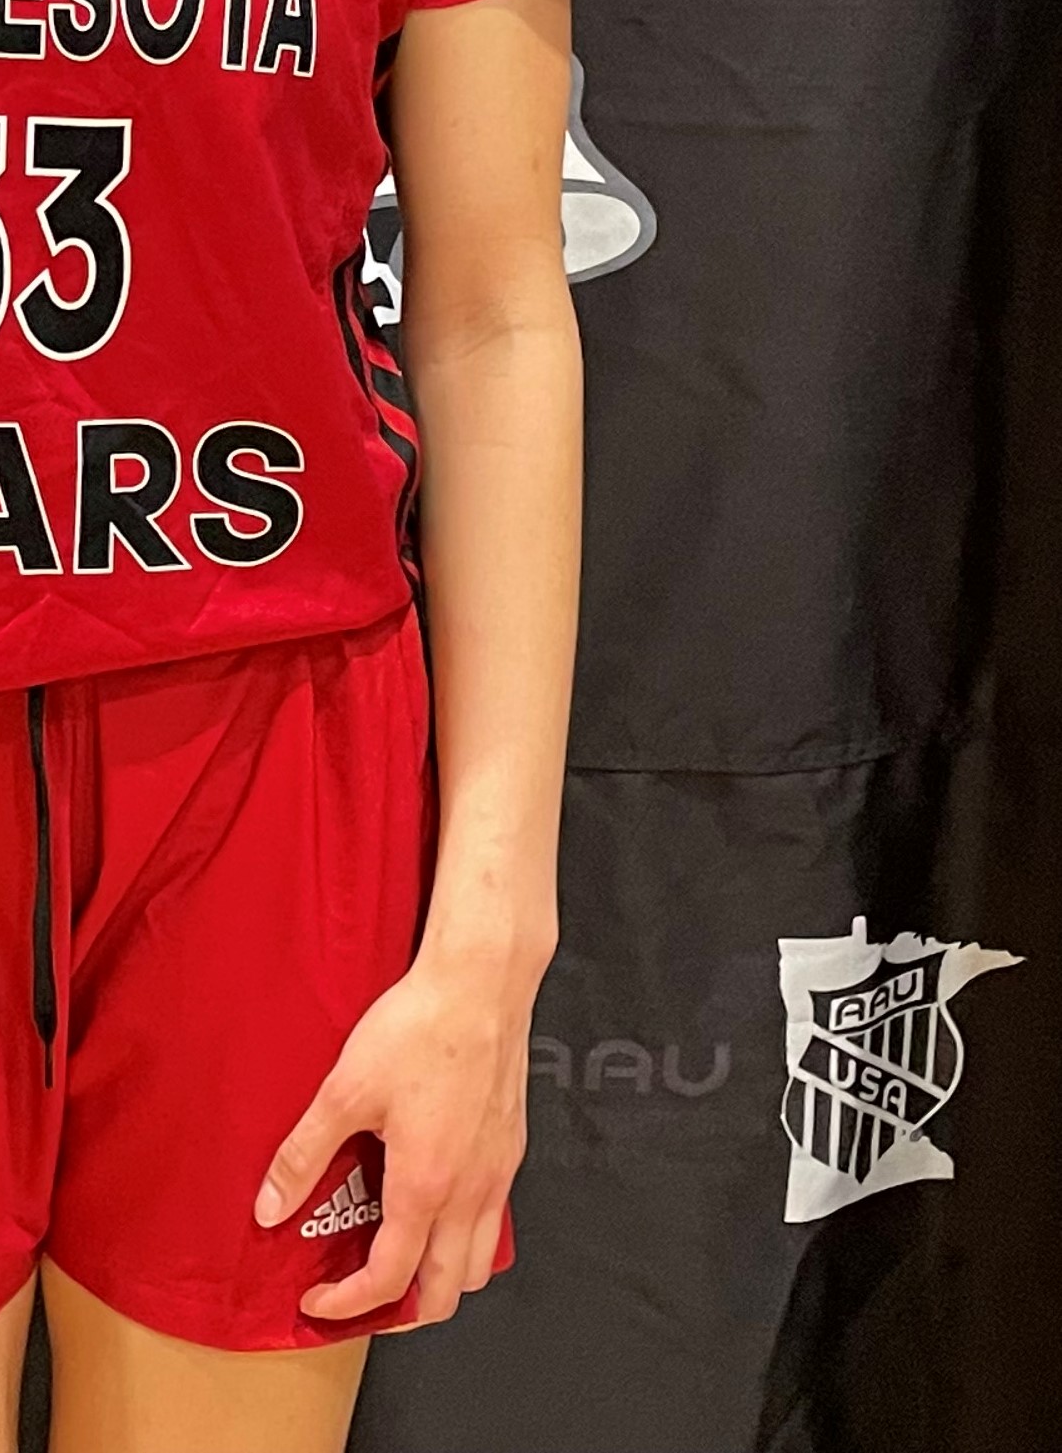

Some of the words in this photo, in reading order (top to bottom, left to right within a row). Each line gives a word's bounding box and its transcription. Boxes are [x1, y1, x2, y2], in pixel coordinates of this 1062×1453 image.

[835, 971, 917, 1028] AAU
[828, 1048, 907, 1118] USA
[300, 1201, 379, 1238] adidas
